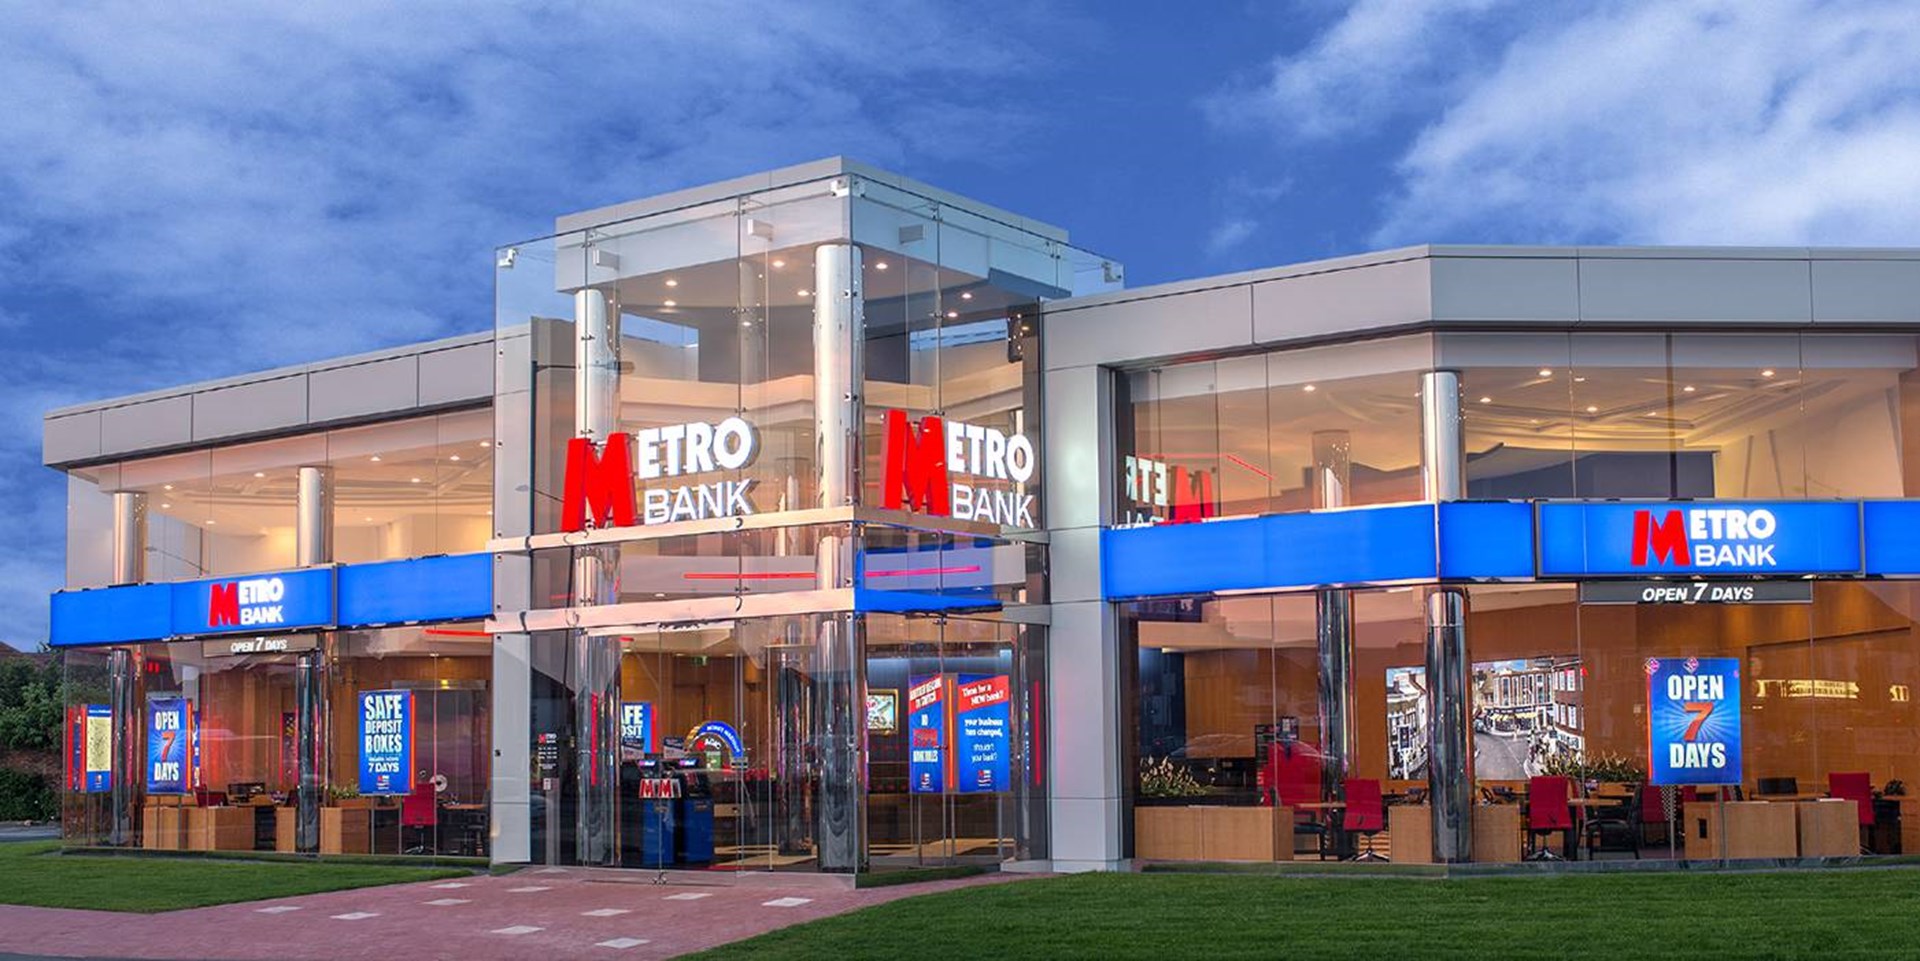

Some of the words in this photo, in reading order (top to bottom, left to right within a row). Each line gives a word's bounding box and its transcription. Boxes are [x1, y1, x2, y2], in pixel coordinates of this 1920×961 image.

[562, 415, 758, 533] METRO
[882, 409, 1035, 516] METRO
[644, 479, 758, 525] BANK
[951, 484, 1035, 529] BANK
[1631, 509, 1777, 567] METRO
[1695, 544, 1777, 567] BANK
[210, 579, 284, 627] METRO
[1642, 587, 1688, 602] OPEN
[1693, 582, 1709, 600] 7
[1711, 587, 1755, 601] DAYS
[241, 606, 284, 625] BANK
[230, 641, 255, 653] OPEN
[255, 636, 264, 651] 7
[265, 639, 288, 652] DAYS
[1667, 674, 1725, 701] OPEN
[155, 710, 180, 731] OPEN
[365, 694, 403, 721] SAFE
[365, 720, 403, 734] DEPOSIT
[1683, 701, 1714, 742] 7
[161, 731, 176, 763] 7
[365, 734, 403, 754] BOXES
[1669, 742, 1726, 770] DAYS
[154, 762, 180, 782] DAYS
[368, 763, 375, 773] 7
[375, 762, 400, 773] DAYS
